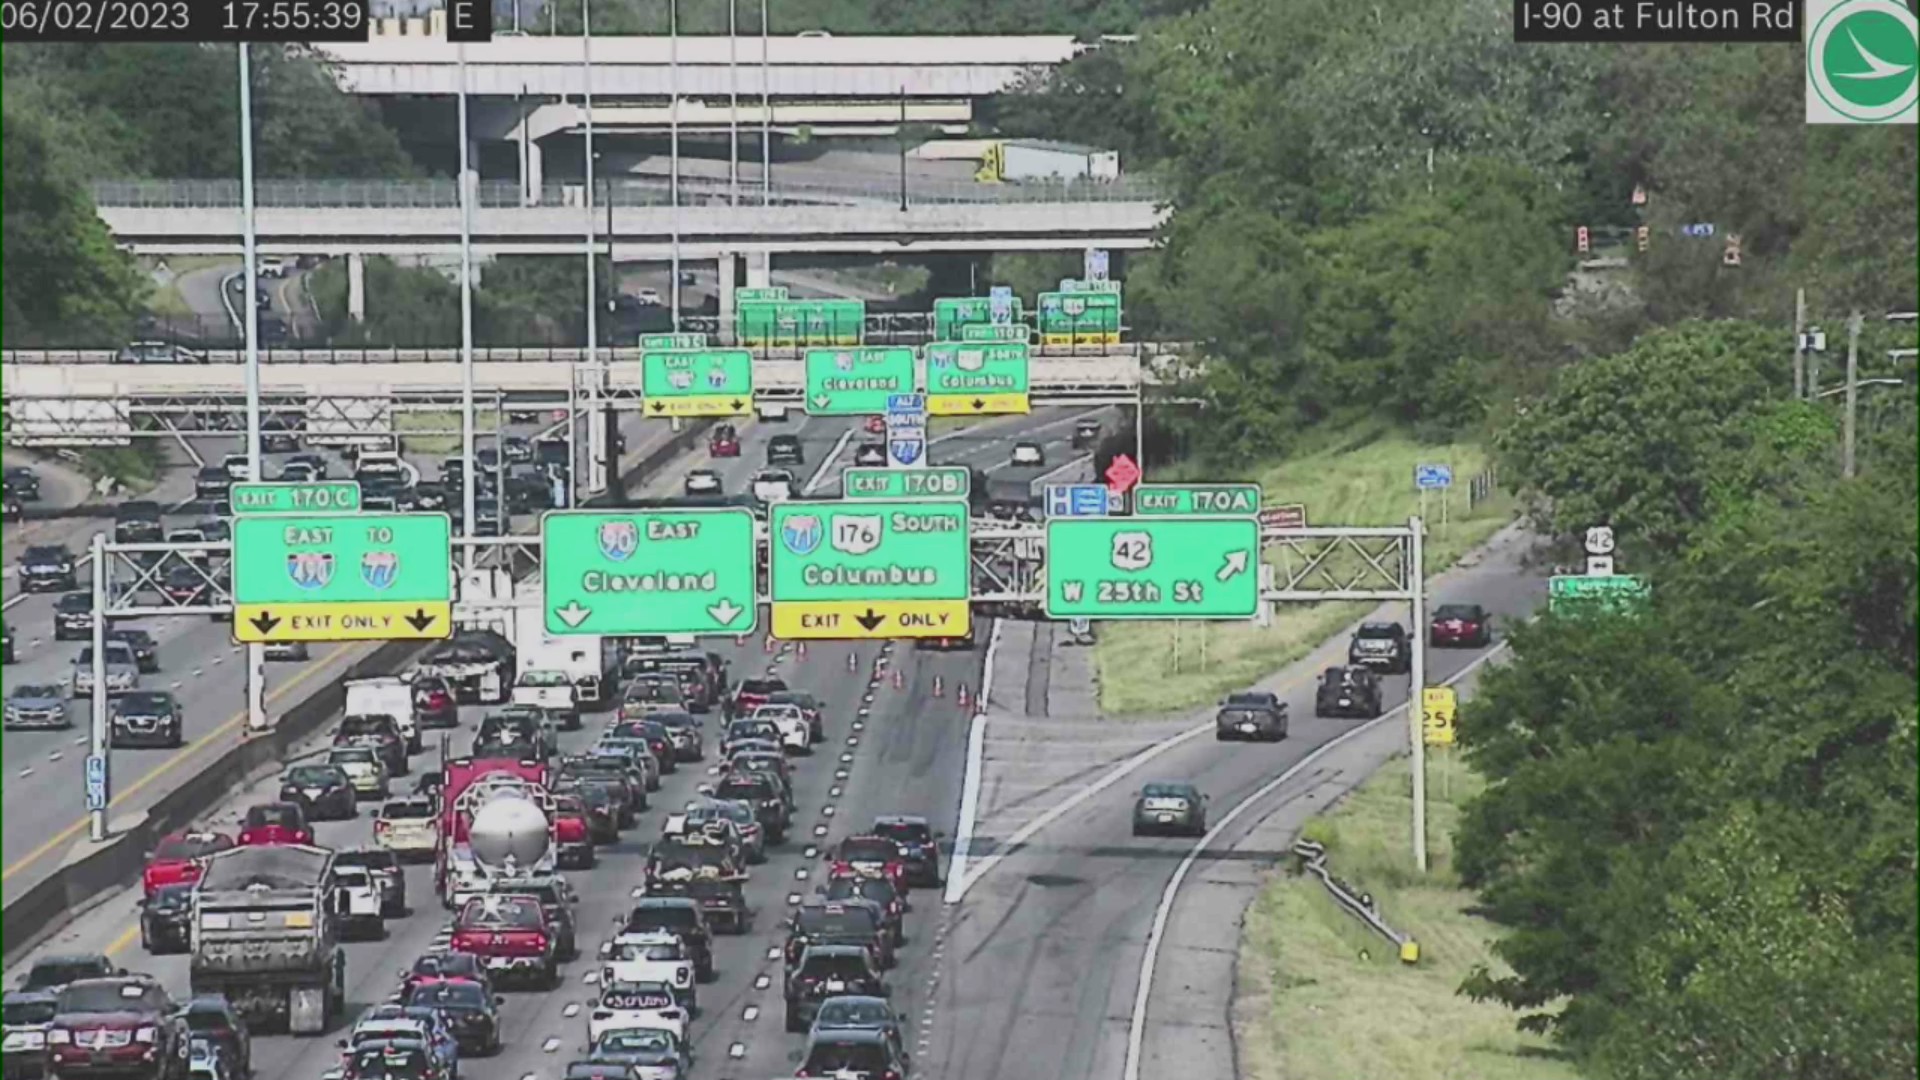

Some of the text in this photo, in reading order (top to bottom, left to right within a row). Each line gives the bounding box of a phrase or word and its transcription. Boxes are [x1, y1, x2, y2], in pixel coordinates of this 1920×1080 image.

[853, 476, 959, 492] EXIT 170B
[241, 491, 275, 505] EXIT
[1142, 491, 1249, 509] EXIT 170A
[646, 520, 701, 539] EAST
[892, 513, 960, 532] SOUTH
[284, 526, 393, 544] EAST TO
[838, 523, 873, 544] 176
[1588, 531, 1612, 549] 42
[1116, 540, 1147, 562] 42
[364, 561, 394, 581] 77
[582, 570, 716, 591] Cleveland
[803, 564, 938, 585] Columbus
[1062, 581, 1204, 602] W 25th St
[291, 614, 392, 629] EXIT ONLY
[802, 612, 950, 628] EXIT ONLY
